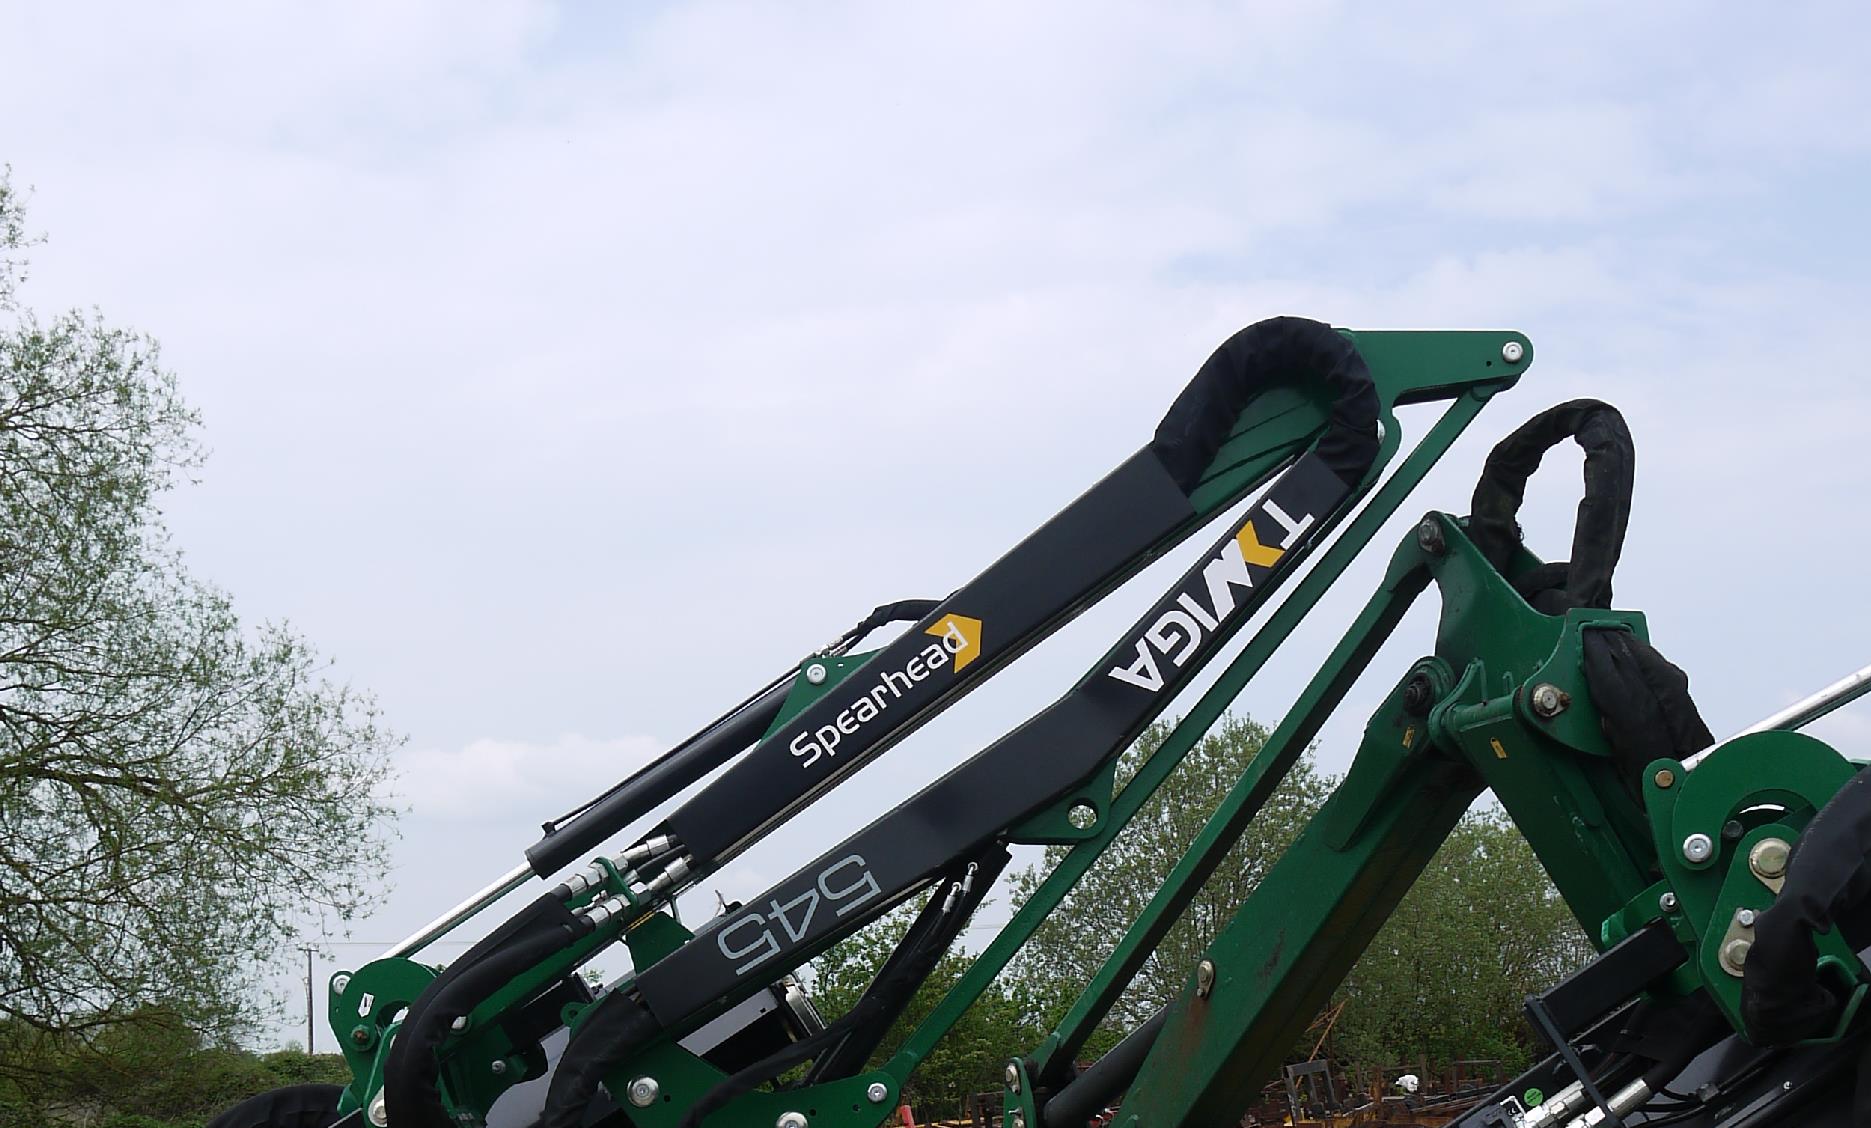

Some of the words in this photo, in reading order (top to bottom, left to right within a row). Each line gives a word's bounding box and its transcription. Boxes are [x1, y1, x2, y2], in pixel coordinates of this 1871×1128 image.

[1108, 498, 1314, 692] TWIGA
[790, 621, 968, 768] Spearhead
[718, 854, 881, 975] 545
